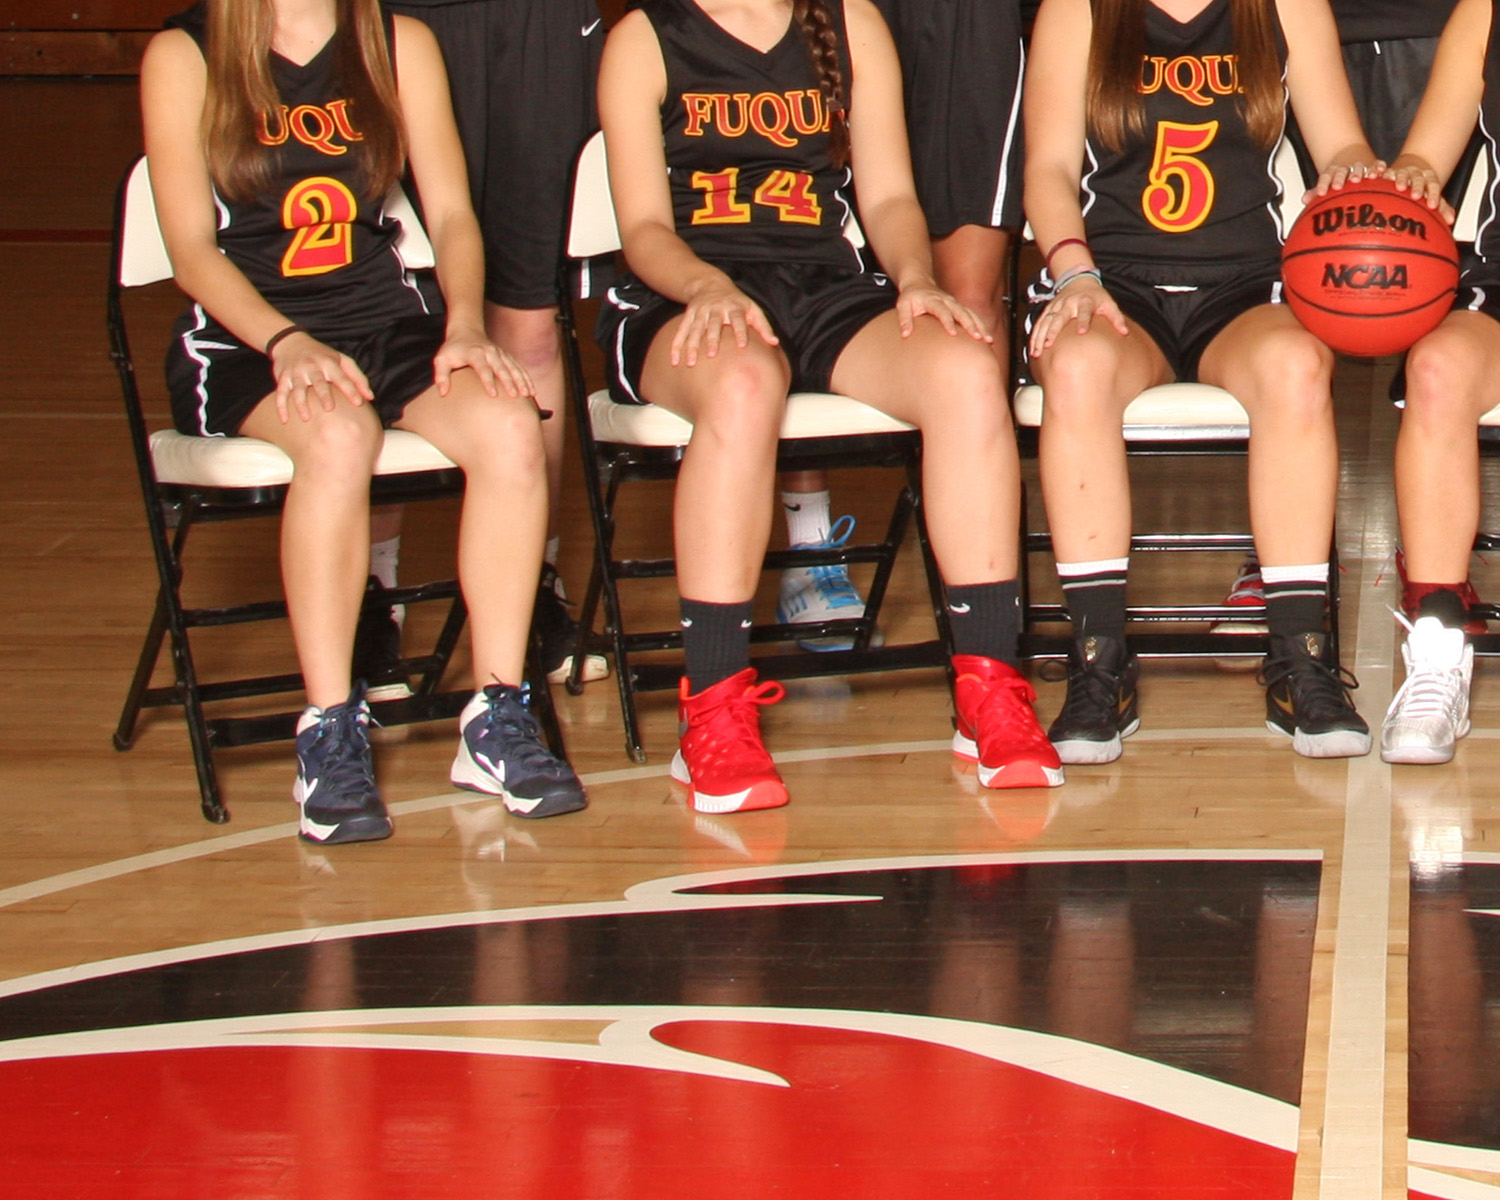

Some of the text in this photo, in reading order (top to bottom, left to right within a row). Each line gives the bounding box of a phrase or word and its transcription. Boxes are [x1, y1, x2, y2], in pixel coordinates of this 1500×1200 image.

[1137, 55, 1245, 106] UQU
[691, 167, 822, 225] 14
[1142, 120, 1219, 233] 5
[281, 176, 357, 277] 2
[1312, 203, 1427, 240] Wilson
[1321, 263, 1408, 290] NCAA
